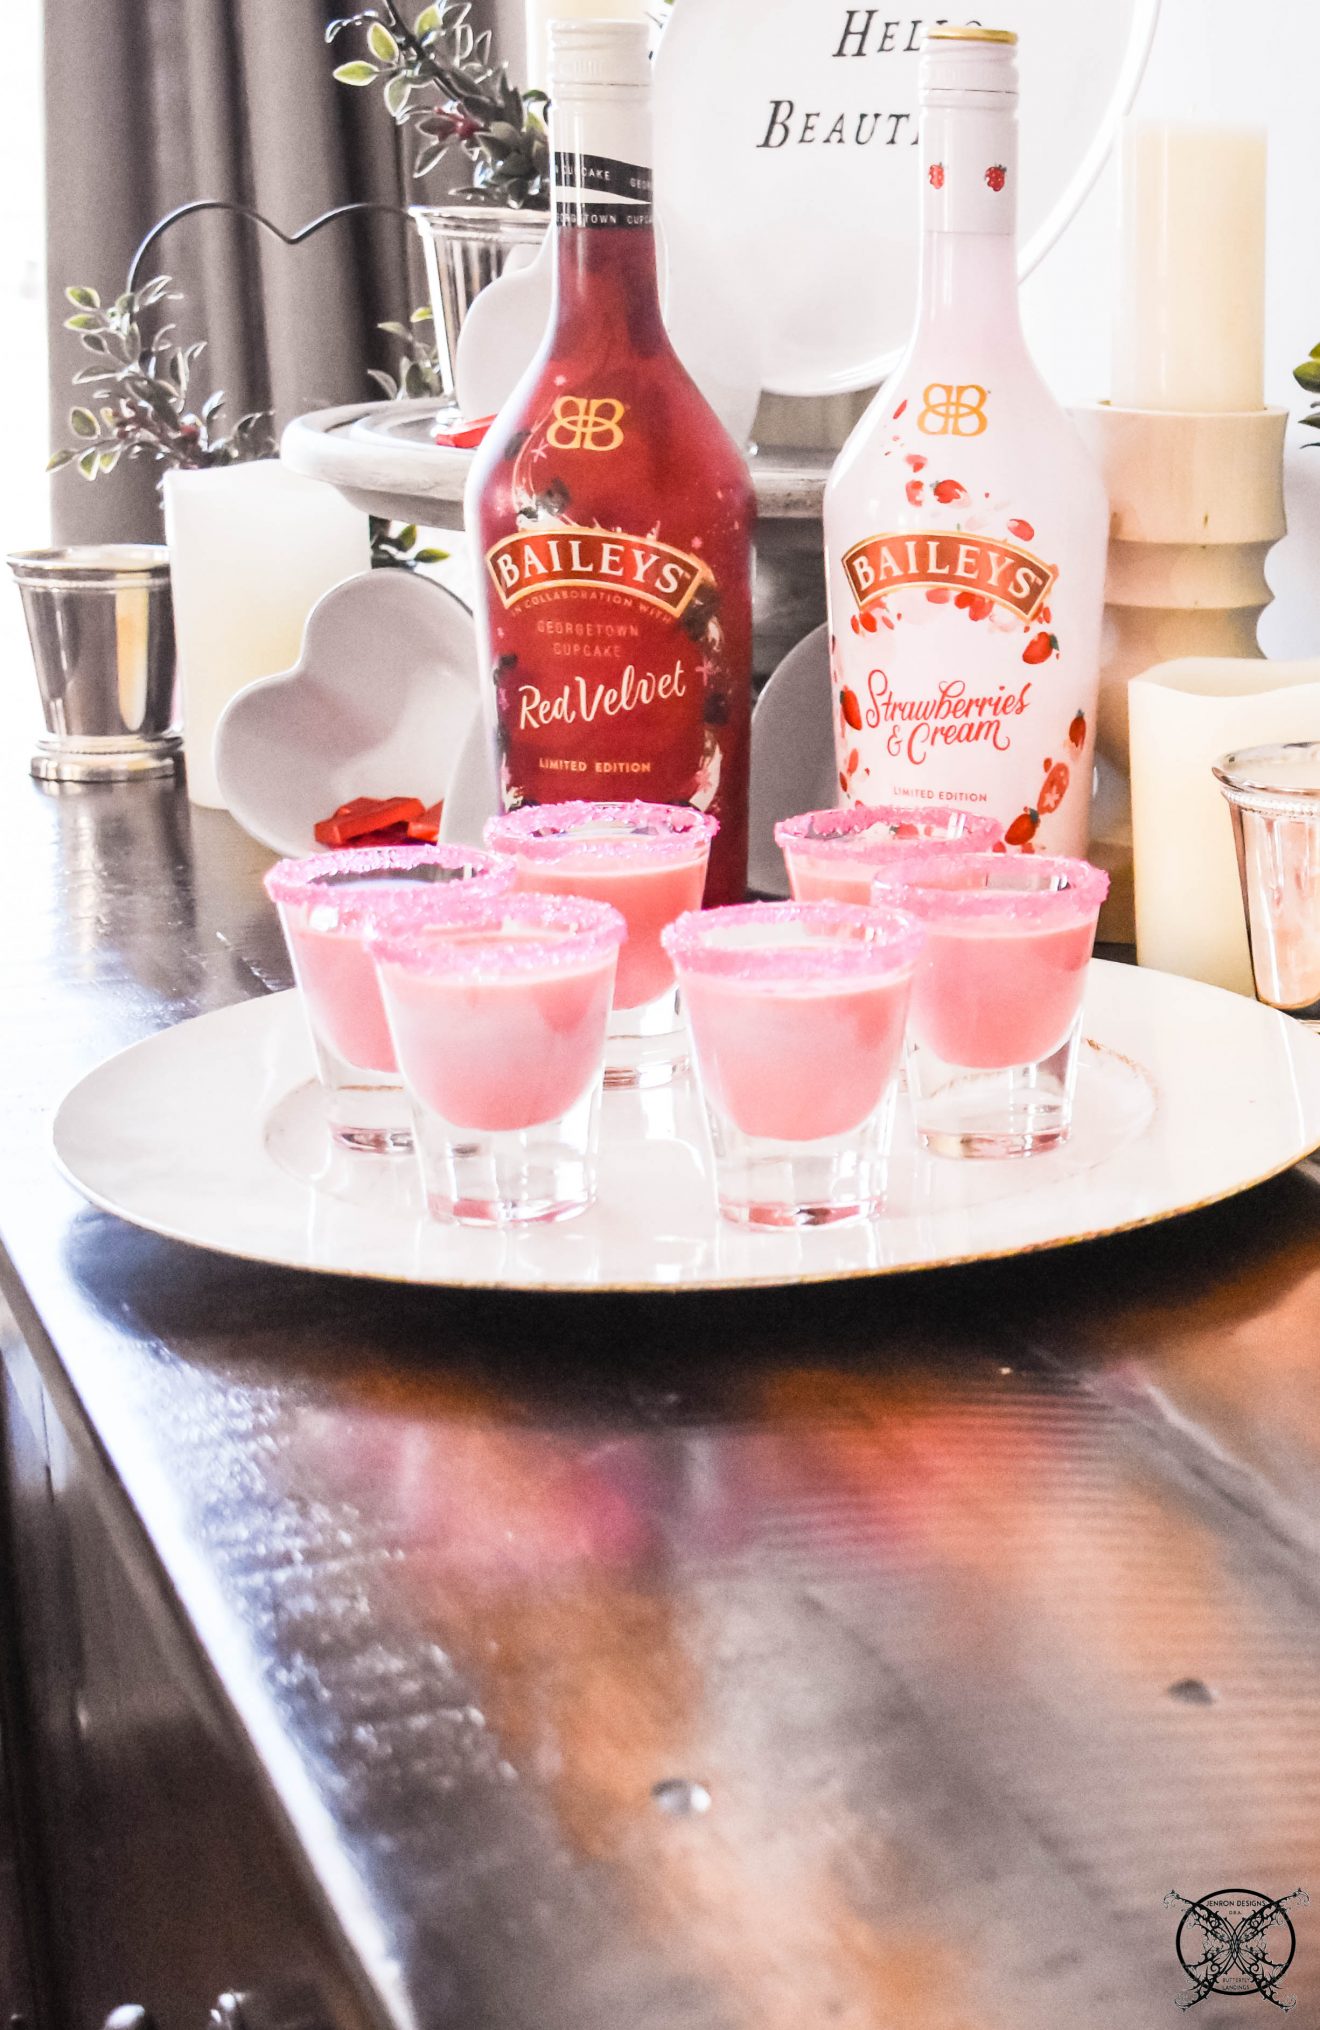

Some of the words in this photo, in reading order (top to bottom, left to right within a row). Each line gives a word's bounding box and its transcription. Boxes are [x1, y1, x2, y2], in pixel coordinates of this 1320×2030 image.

[832, 9, 981, 57] HEL
[563, 165, 611, 180] CUCAKE
[497, 540, 684, 594] BAILEYS
[853, 541, 1041, 599] BAILEYS
[511, 607, 522, 617] IN
[525, 590, 633, 609] COLLABORATION
[639, 604, 672, 624] WITH
[536, 620, 639, 637] GEORGETOWN
[552, 642, 621, 658] CUPCAKE
[518, 684, 576, 730] Red
[574, 659, 686, 722] Velvet
[865, 669, 1032, 728] Strawberries
[887, 724, 903, 757] &
[907, 718, 1011, 765] Cream
[539, 757, 587, 773] LIMITED
[595, 761, 651, 774] EDITION
[893, 786, 935, 800] LIMITED
[938, 790, 988, 803] EDITION
